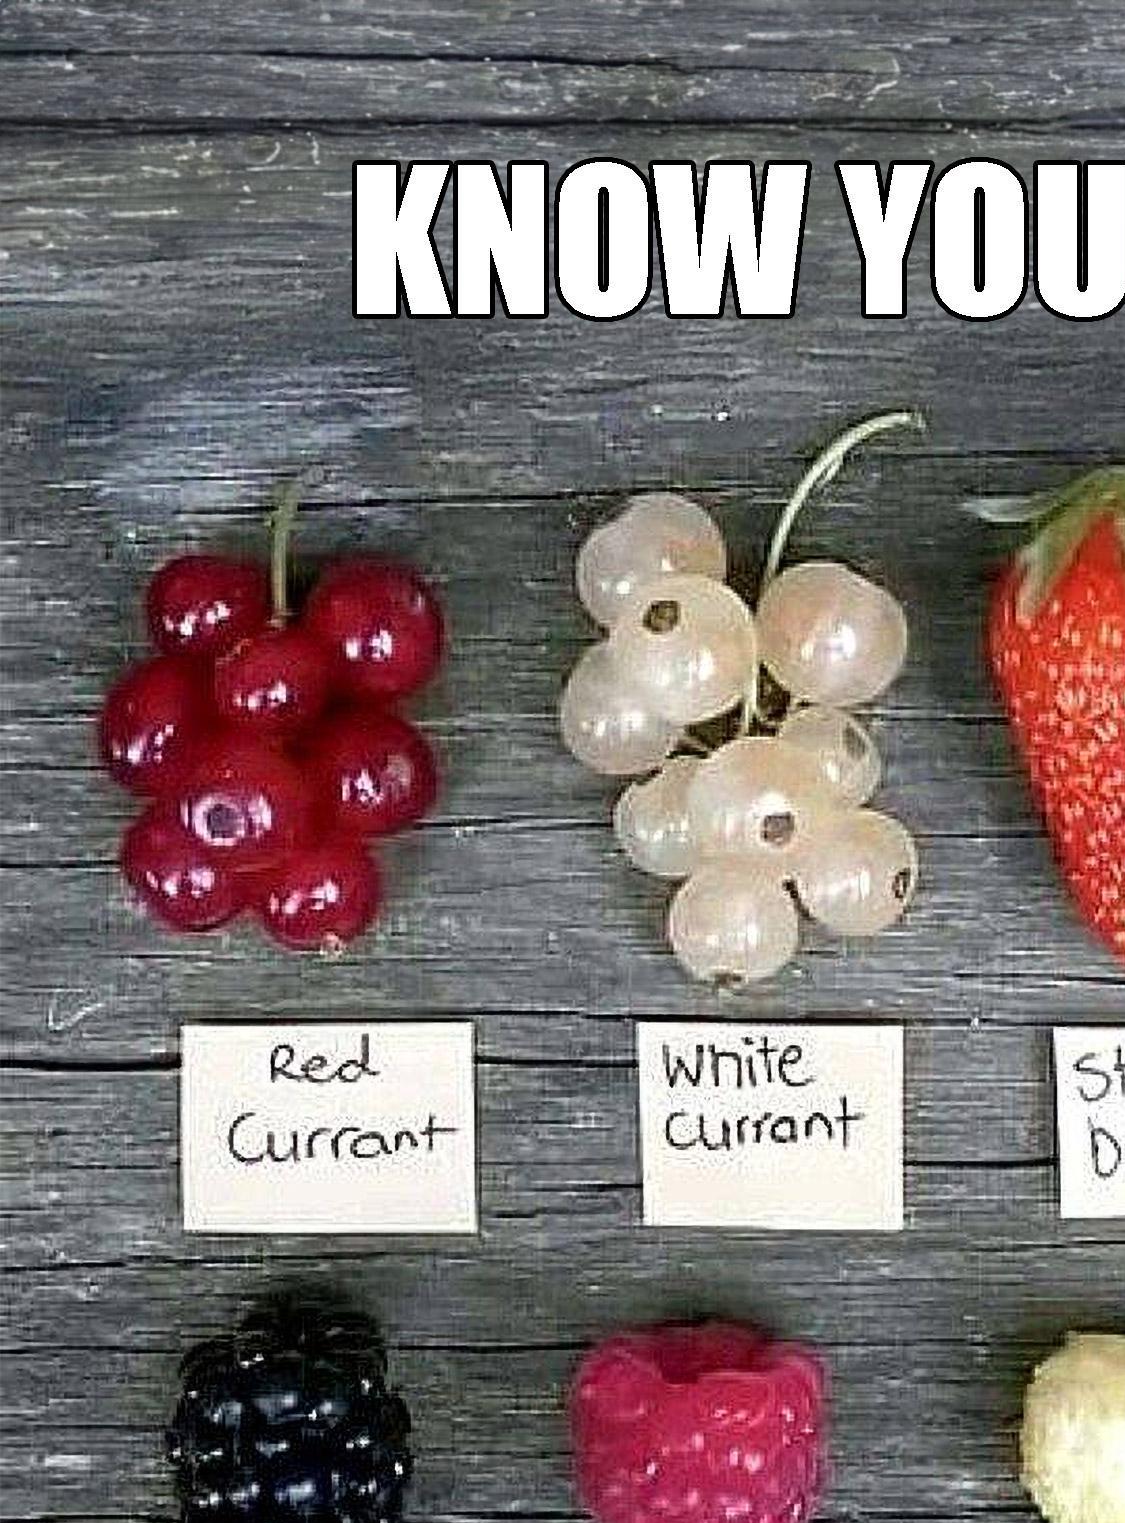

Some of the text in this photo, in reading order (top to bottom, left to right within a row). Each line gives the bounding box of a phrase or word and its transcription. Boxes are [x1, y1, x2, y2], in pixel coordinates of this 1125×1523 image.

[270, 1033, 380, 1084] Red
[662, 1036, 816, 1089] White
[227, 1112, 459, 1166] Currant
